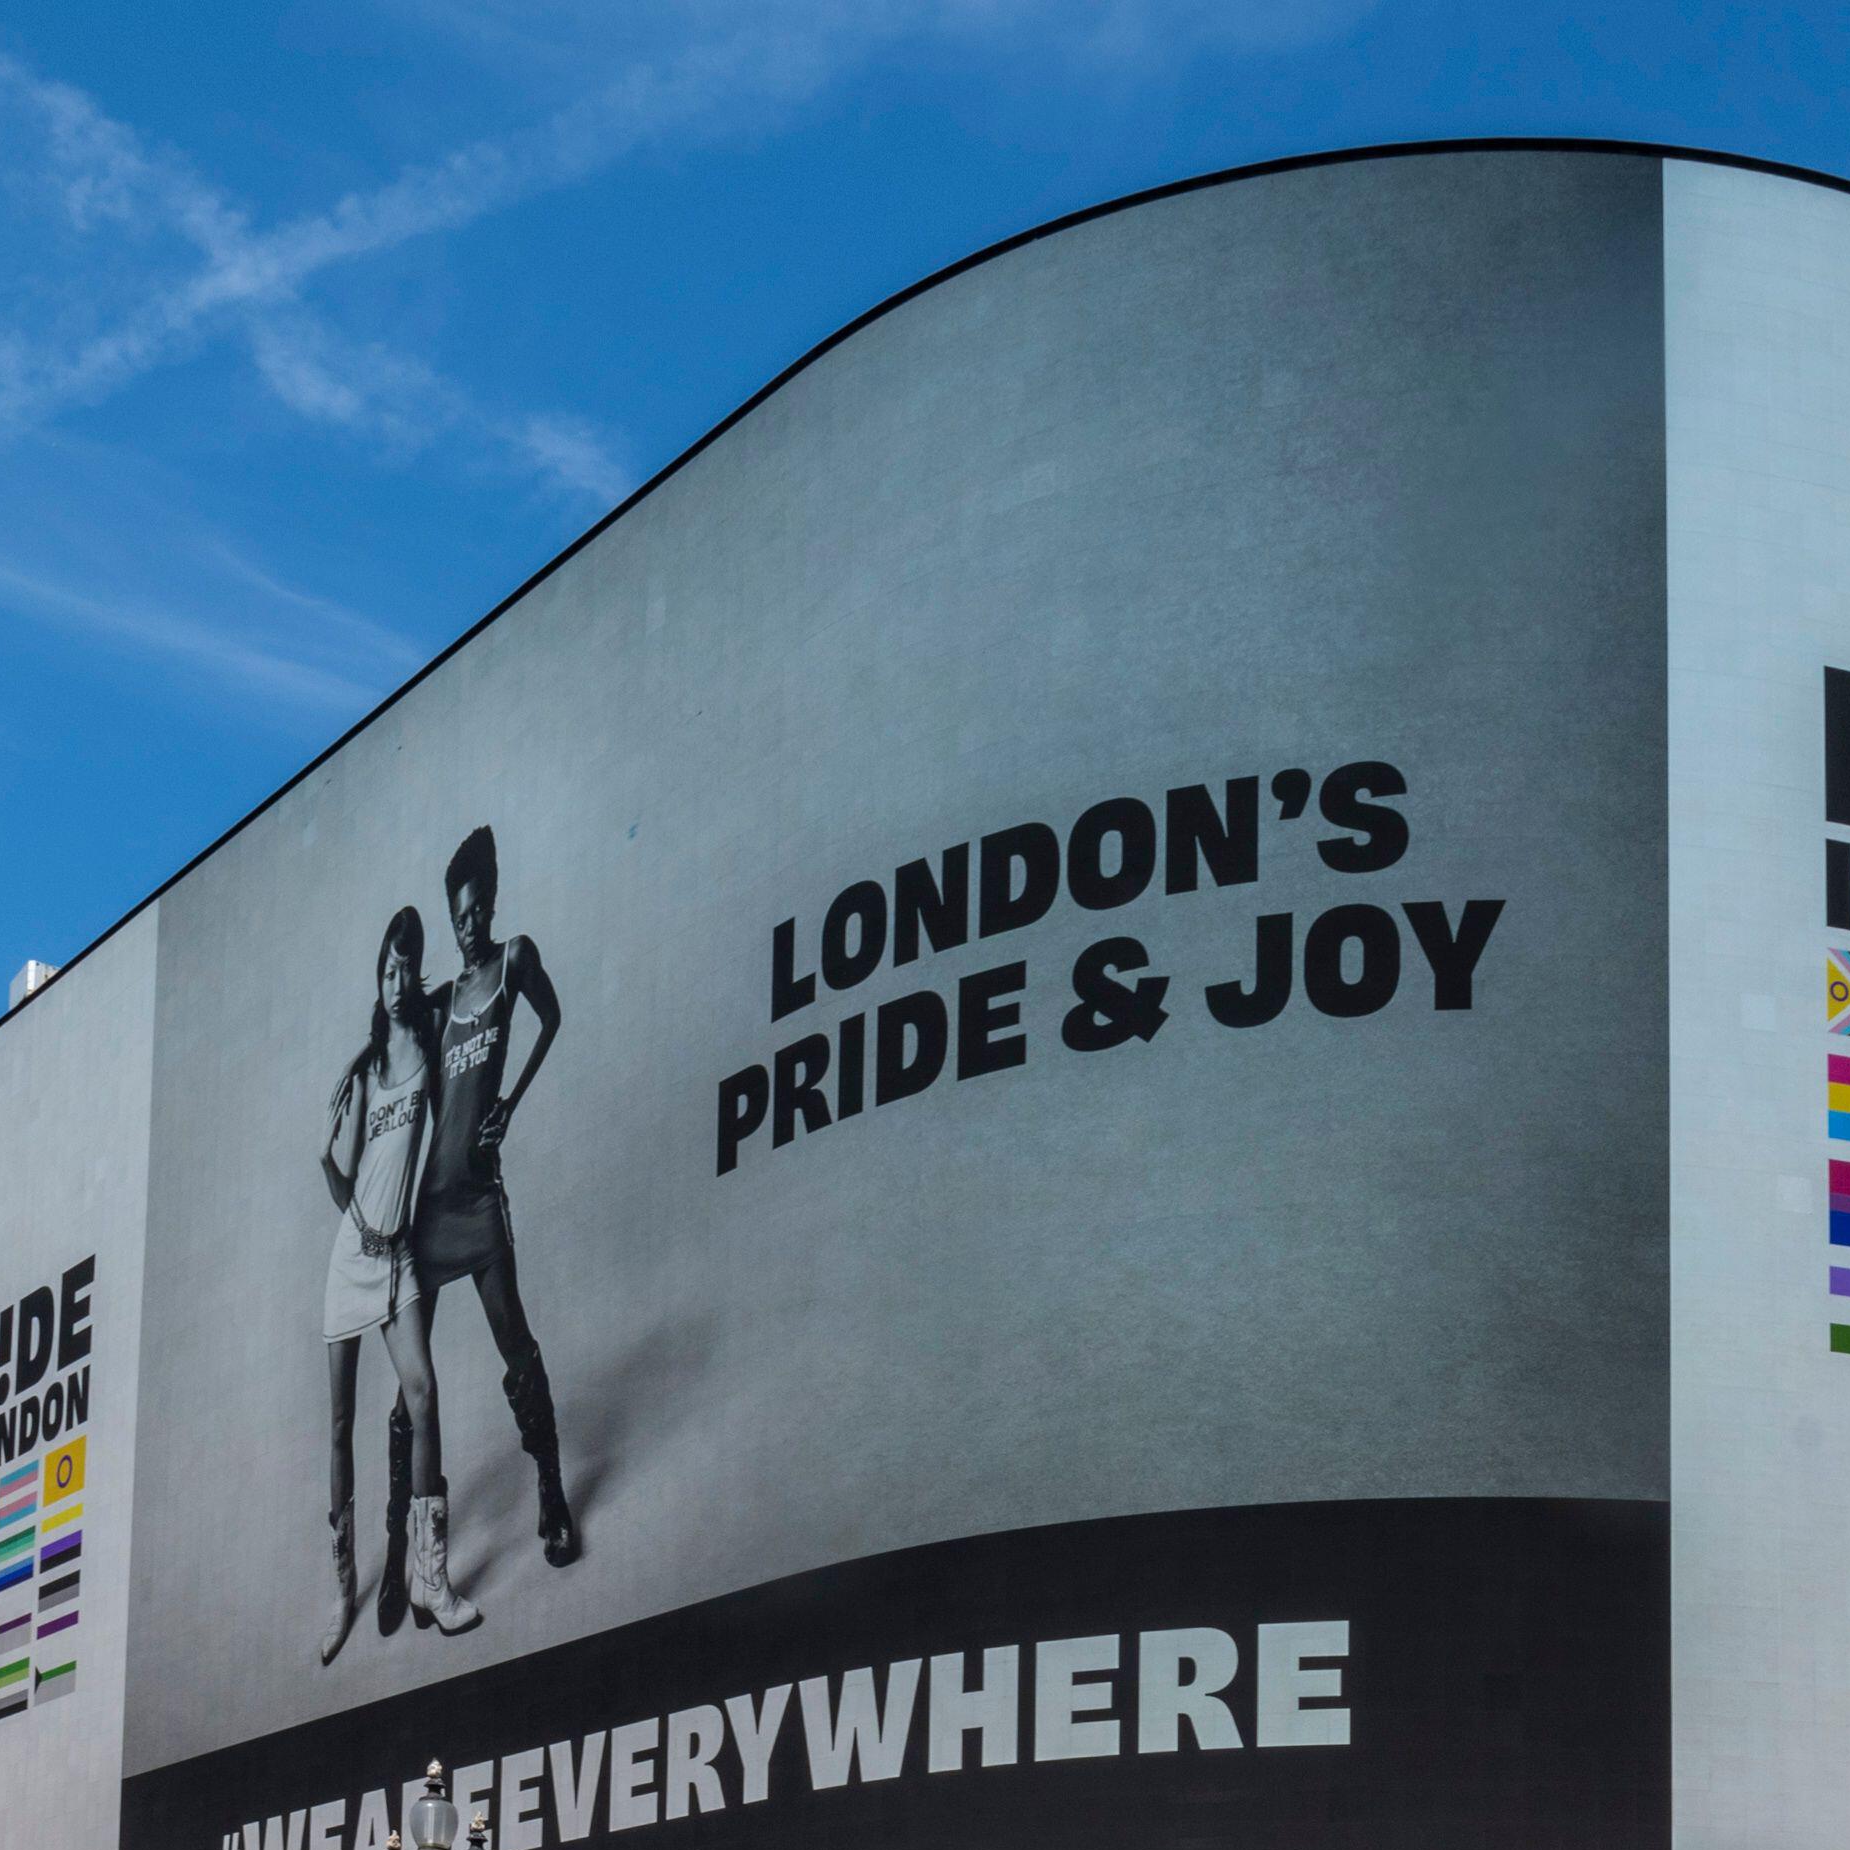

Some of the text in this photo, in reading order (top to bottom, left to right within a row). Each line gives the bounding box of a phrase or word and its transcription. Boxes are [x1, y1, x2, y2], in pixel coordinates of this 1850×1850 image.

[771, 760, 1410, 1023] LONDON'S
[717, 899, 1507, 1177] PRIDE & JOY
